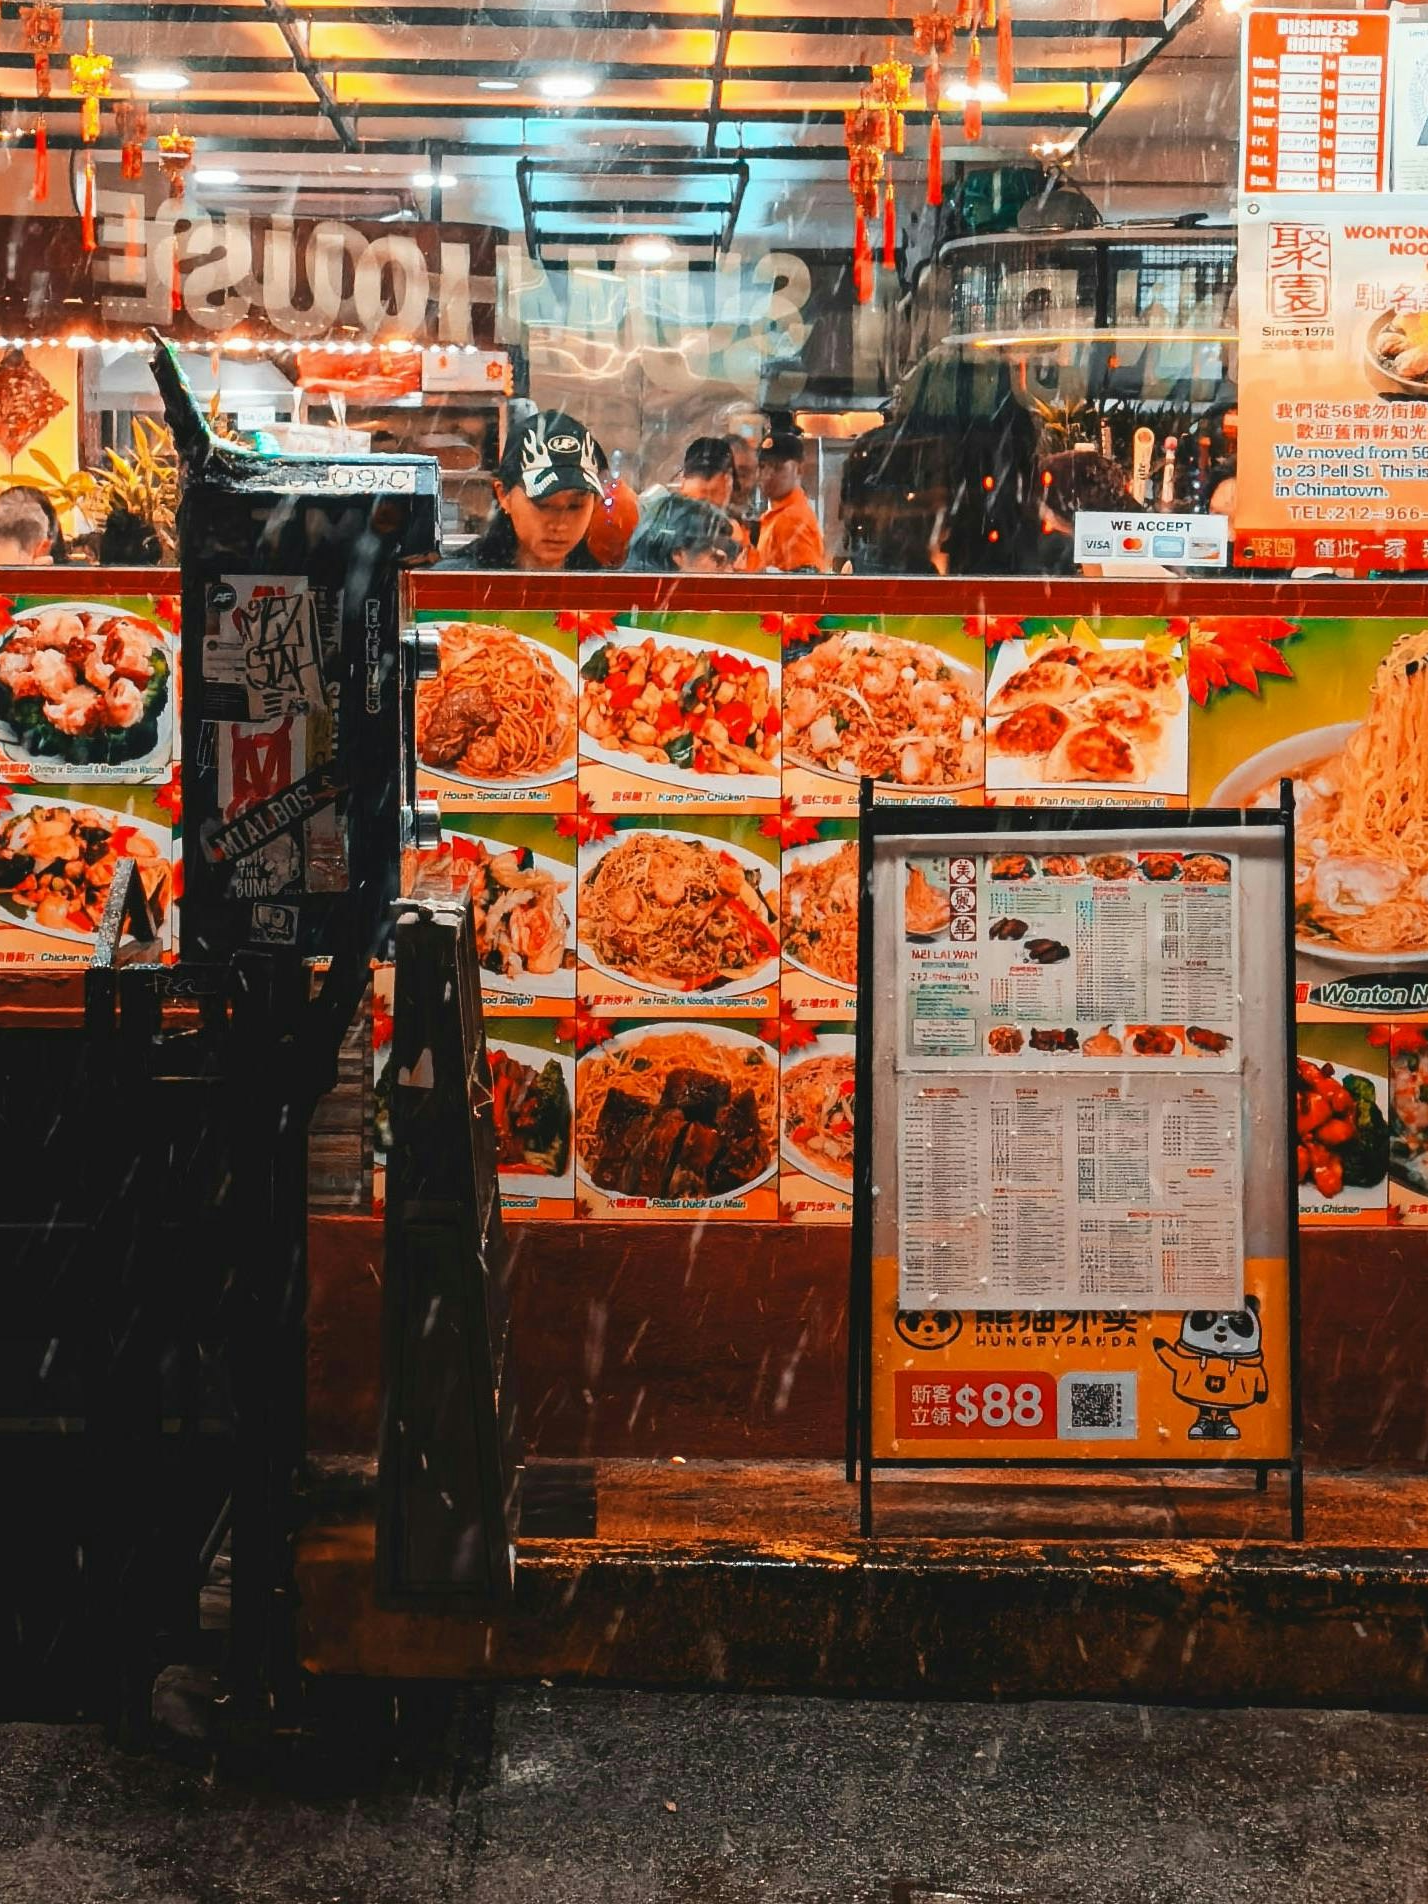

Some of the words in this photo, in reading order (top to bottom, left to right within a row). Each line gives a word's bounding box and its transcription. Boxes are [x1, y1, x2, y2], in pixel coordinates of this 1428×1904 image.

[1278, 19, 1358, 36] BUSINESS
[1251, 135, 1268, 146] Fri.
[1276, 446, 1303, 459] We
[1308, 446, 1364, 459] moved
[1369, 446, 1407, 459] from
[1276, 467, 1292, 478] to
[1297, 466, 1316, 477] 23
[1321, 466, 1348, 478] Pell
[1380, 466, 1412, 478] This
[1276, 484, 1289, 496] in
[1111, 521, 1132, 531] WE
[1137, 521, 1192, 532] ACCEPT
[1086, 540, 1110, 549] VISA
[443, 791, 474, 799] House
[477, 791, 510, 800] Special
[658, 793, 683, 803] Kung
[687, 793, 704, 801] Pao
[707, 793, 745, 801] Chicken
[912, 797, 934, 805] Fried
[1040, 797, 1058, 805] Pan
[1061, 797, 1084, 805] Fried
[1087, 797, 1102, 807] Big
[1106, 797, 1150, 807] Dumpling
[41, 953, 80, 962] Chicken
[912, 950, 930, 959] MEI
[934, 951, 950, 959] LAI
[1323, 984, 1409, 1004] Wonton
[639, 997, 651, 1005] Pan
[653, 1200, 680, 1208] Roast
[683, 1200, 706, 1208] Duck
[709, 1200, 721, 1208] Lo
[1322, 1205, 1359, 1213] Chicken
[976, 1336, 1137, 1347] HUNGRYPANDA
[955, 1383, 1043, 1427] $88
